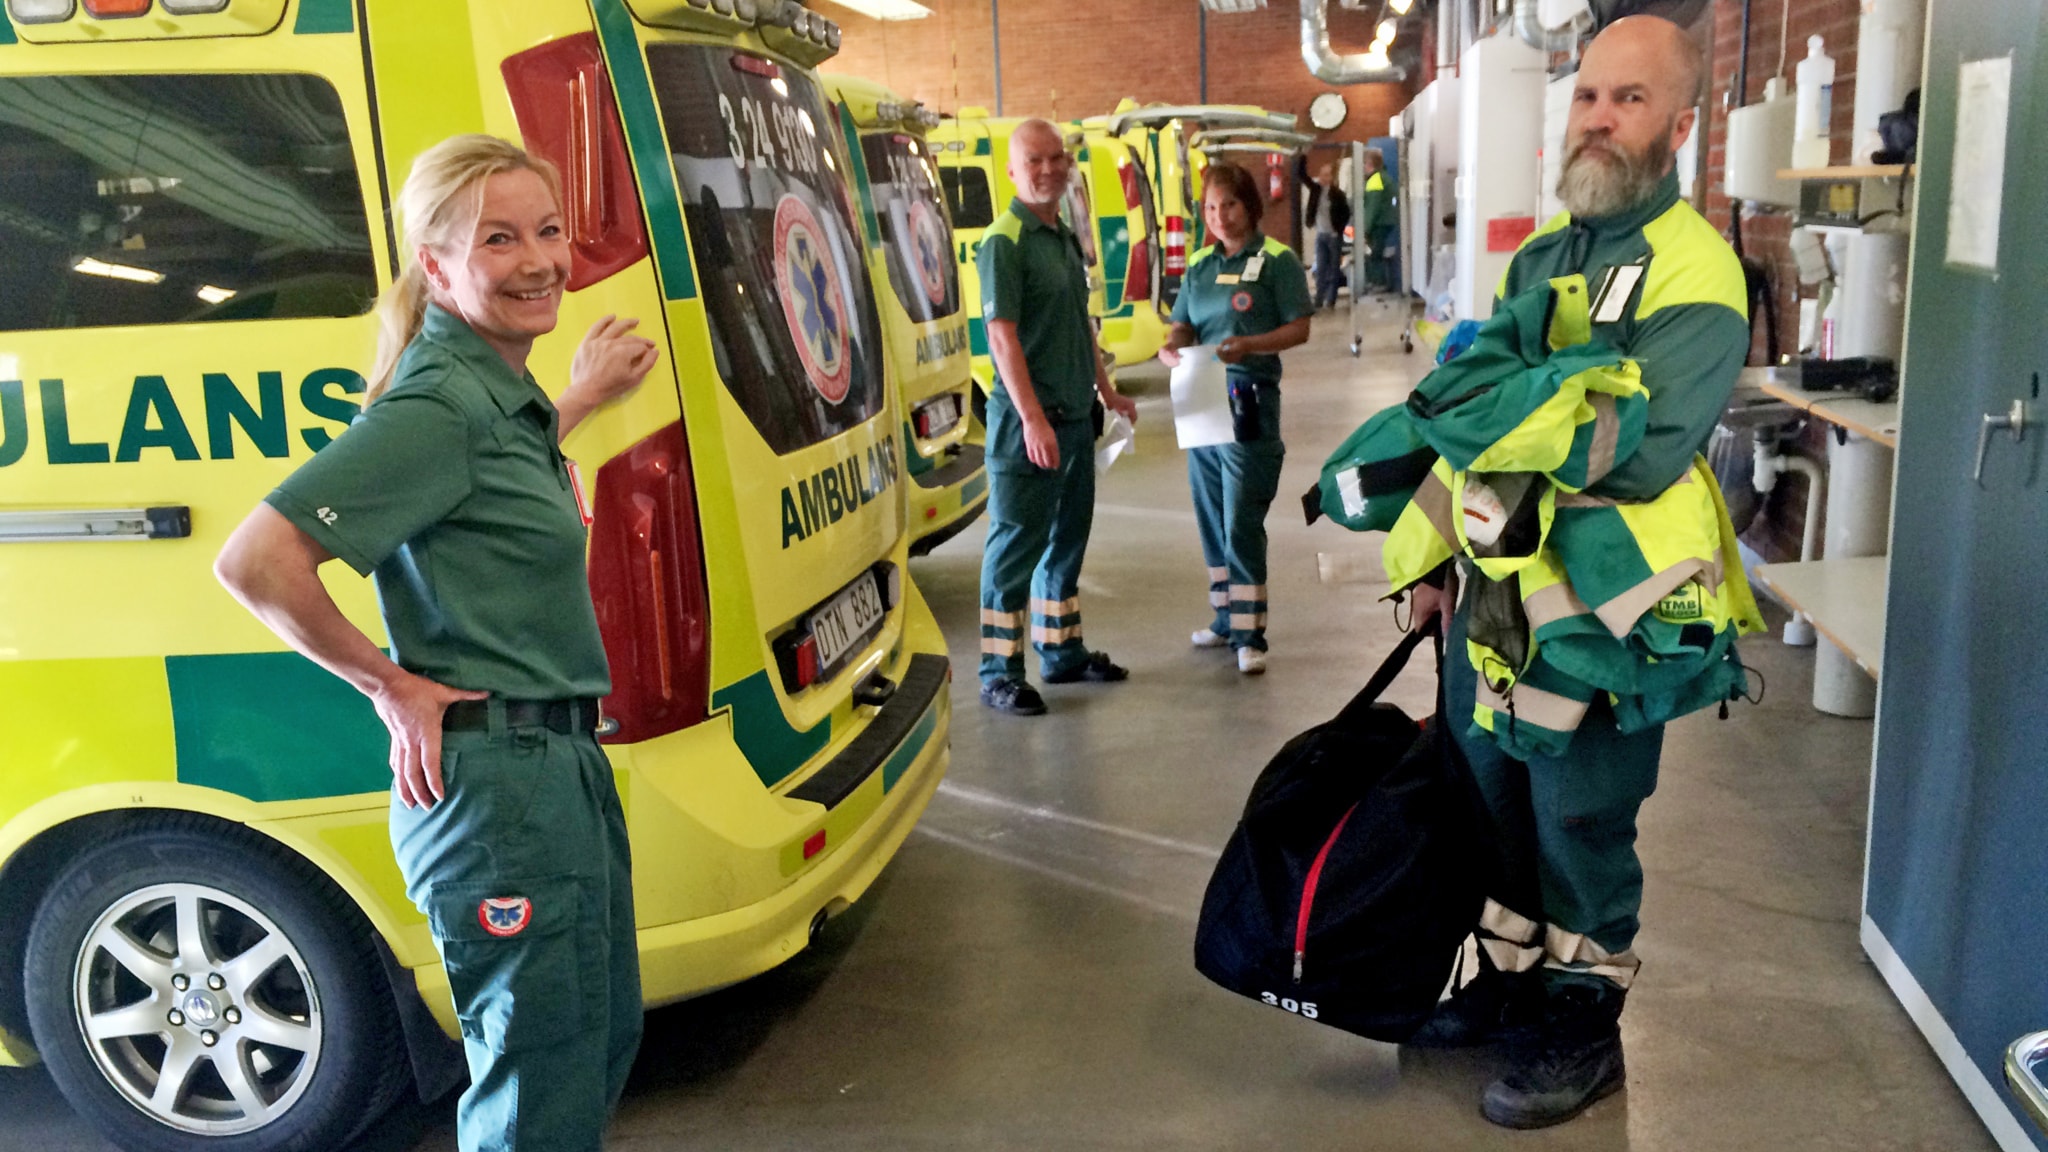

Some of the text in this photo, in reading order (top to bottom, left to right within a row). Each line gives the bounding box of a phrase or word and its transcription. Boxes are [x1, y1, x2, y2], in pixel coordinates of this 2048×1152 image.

[719, 93, 745, 169] 3
[741, 96, 777, 169] 24
[316, 506, 338, 526] 42
[781, 434, 898, 550] AMBULANS
[815, 603, 849, 662] DTN
[850, 578, 880, 628] 882
[1663, 600, 1697, 610] TMB
[1261, 991, 1319, 1019] 305
